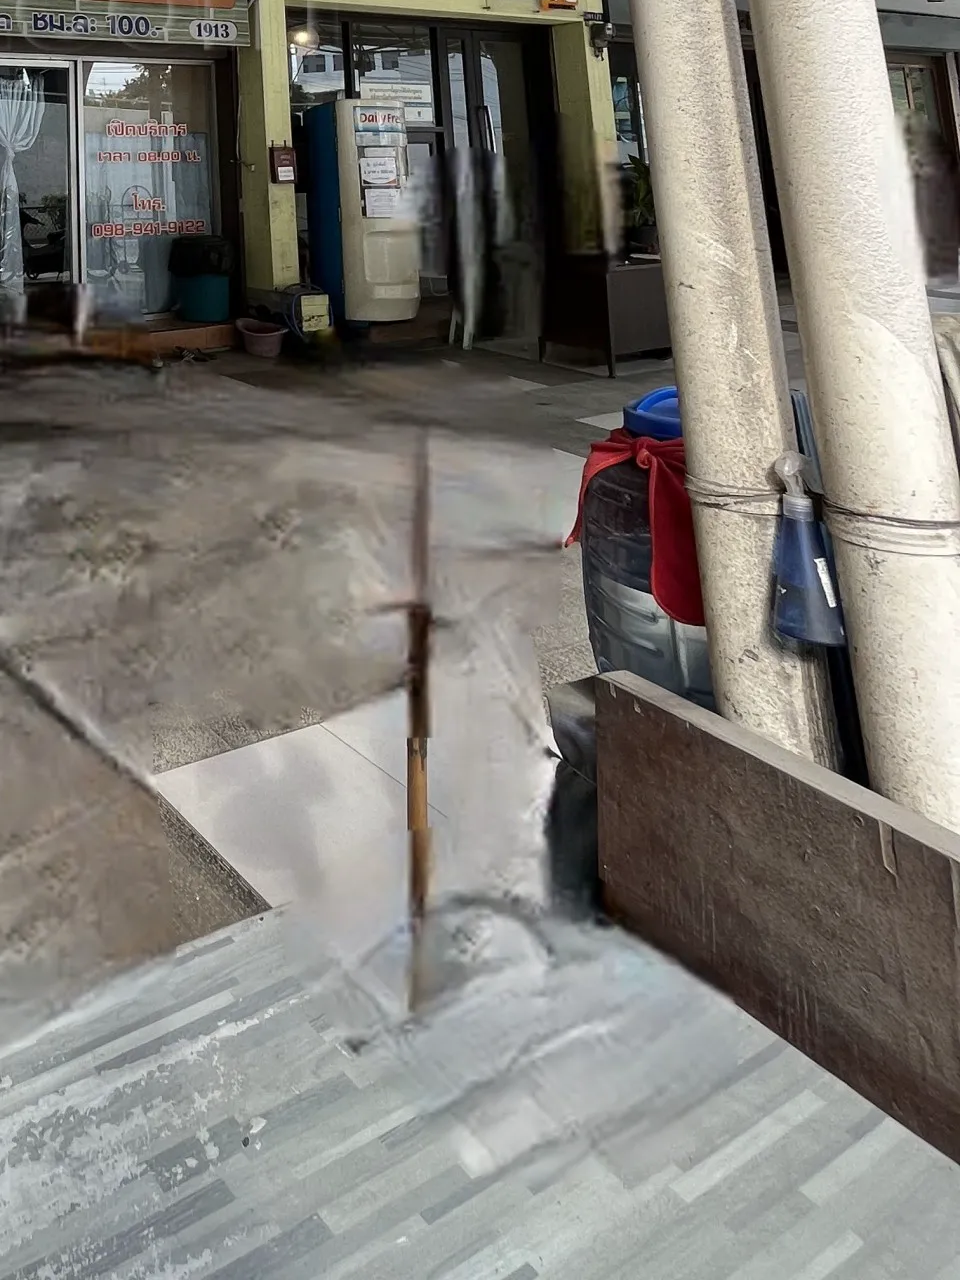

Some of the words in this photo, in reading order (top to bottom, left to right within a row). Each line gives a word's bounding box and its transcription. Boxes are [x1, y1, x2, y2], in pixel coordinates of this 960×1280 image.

[106, 15, 165, 37] 100.-
[196, 22, 231, 39] 1913
[106, 119, 188, 137] เปิดบริการ
[97, 150, 131, 162] เวลา
[132, 190, 166, 211] โทร.
[92, 220, 205, 238] 098-941-9122
